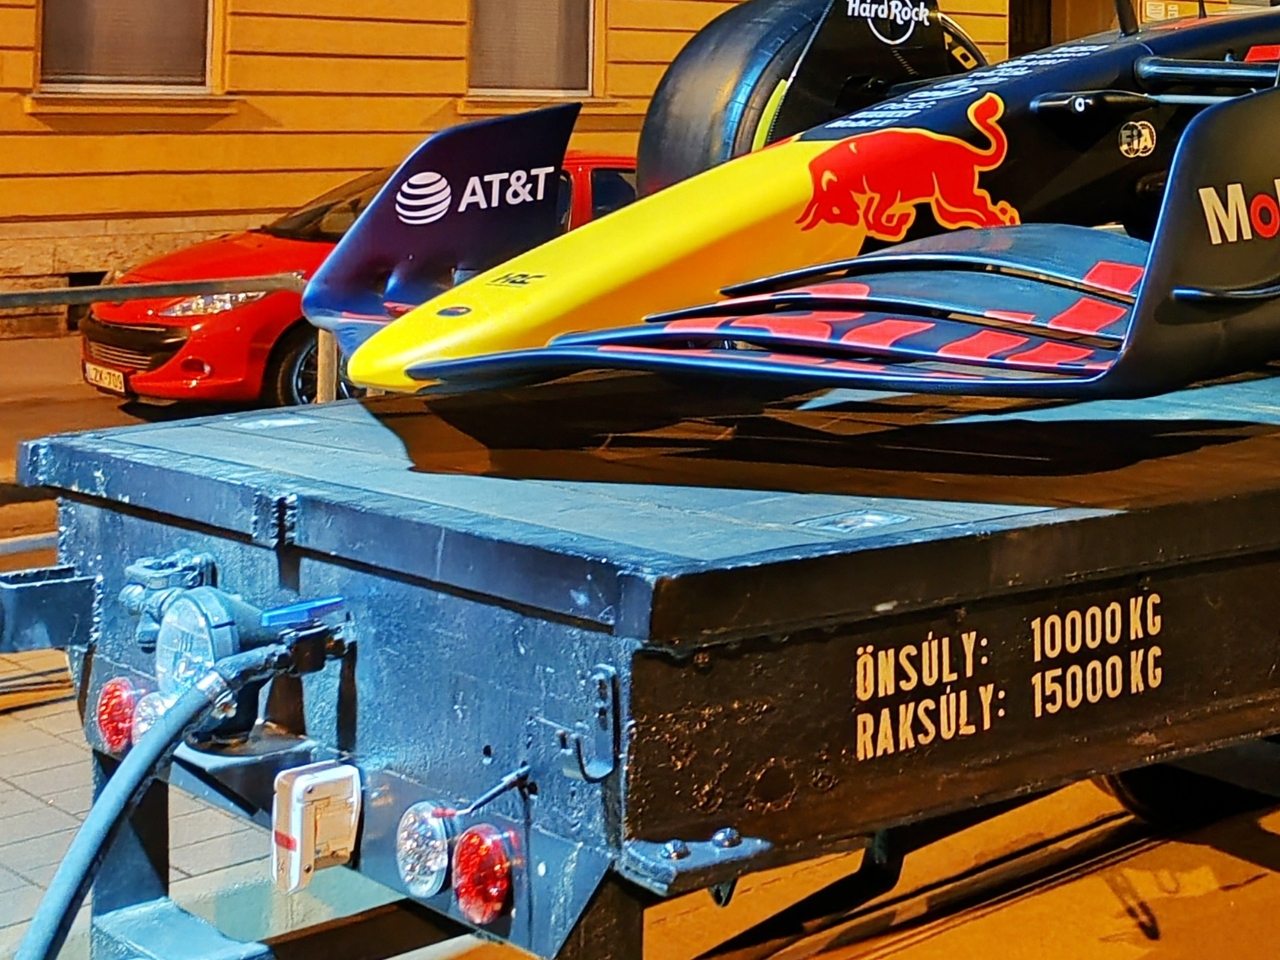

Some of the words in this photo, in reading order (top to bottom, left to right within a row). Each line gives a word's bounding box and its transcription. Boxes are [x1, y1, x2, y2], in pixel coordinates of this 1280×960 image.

[457, 166, 555, 213] AT&T
[855, 631, 989, 702] ÖNSÚLY:
[1030, 601, 1122, 663] 10000
[1129, 593, 1163, 641] KG
[856, 683, 1006, 762] RAKSÚLY:
[1030, 648, 1123, 718] 15000
[1129, 645, 1163, 694] KG
